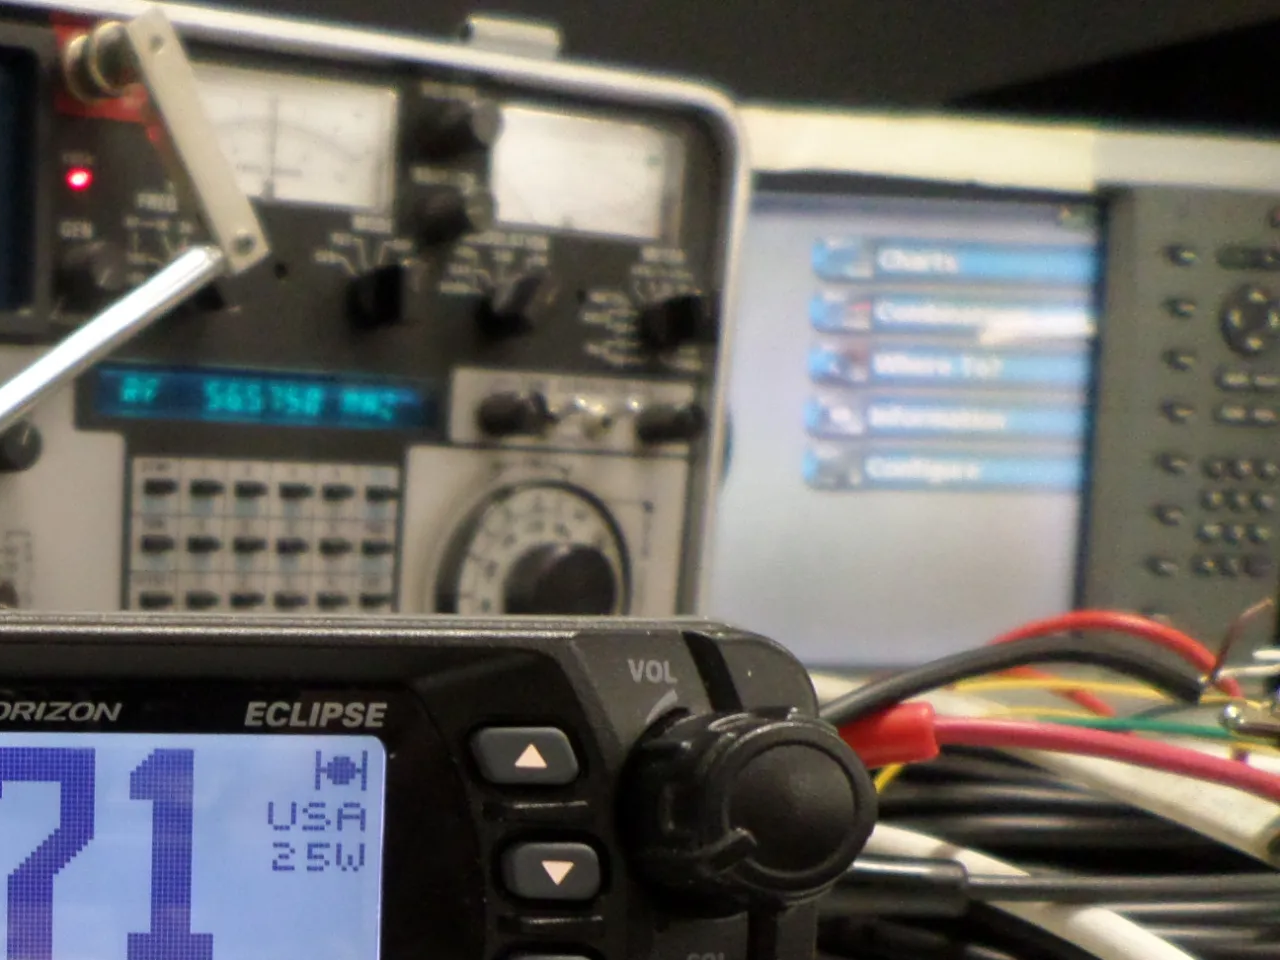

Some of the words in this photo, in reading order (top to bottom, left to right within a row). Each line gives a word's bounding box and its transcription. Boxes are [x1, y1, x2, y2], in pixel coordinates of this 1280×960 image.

[627, 658, 678, 685] VOL
[243, 701, 388, 729] ECLIPSE
[267, 801, 367, 832] USA
[271, 842, 366, 872] 25W
